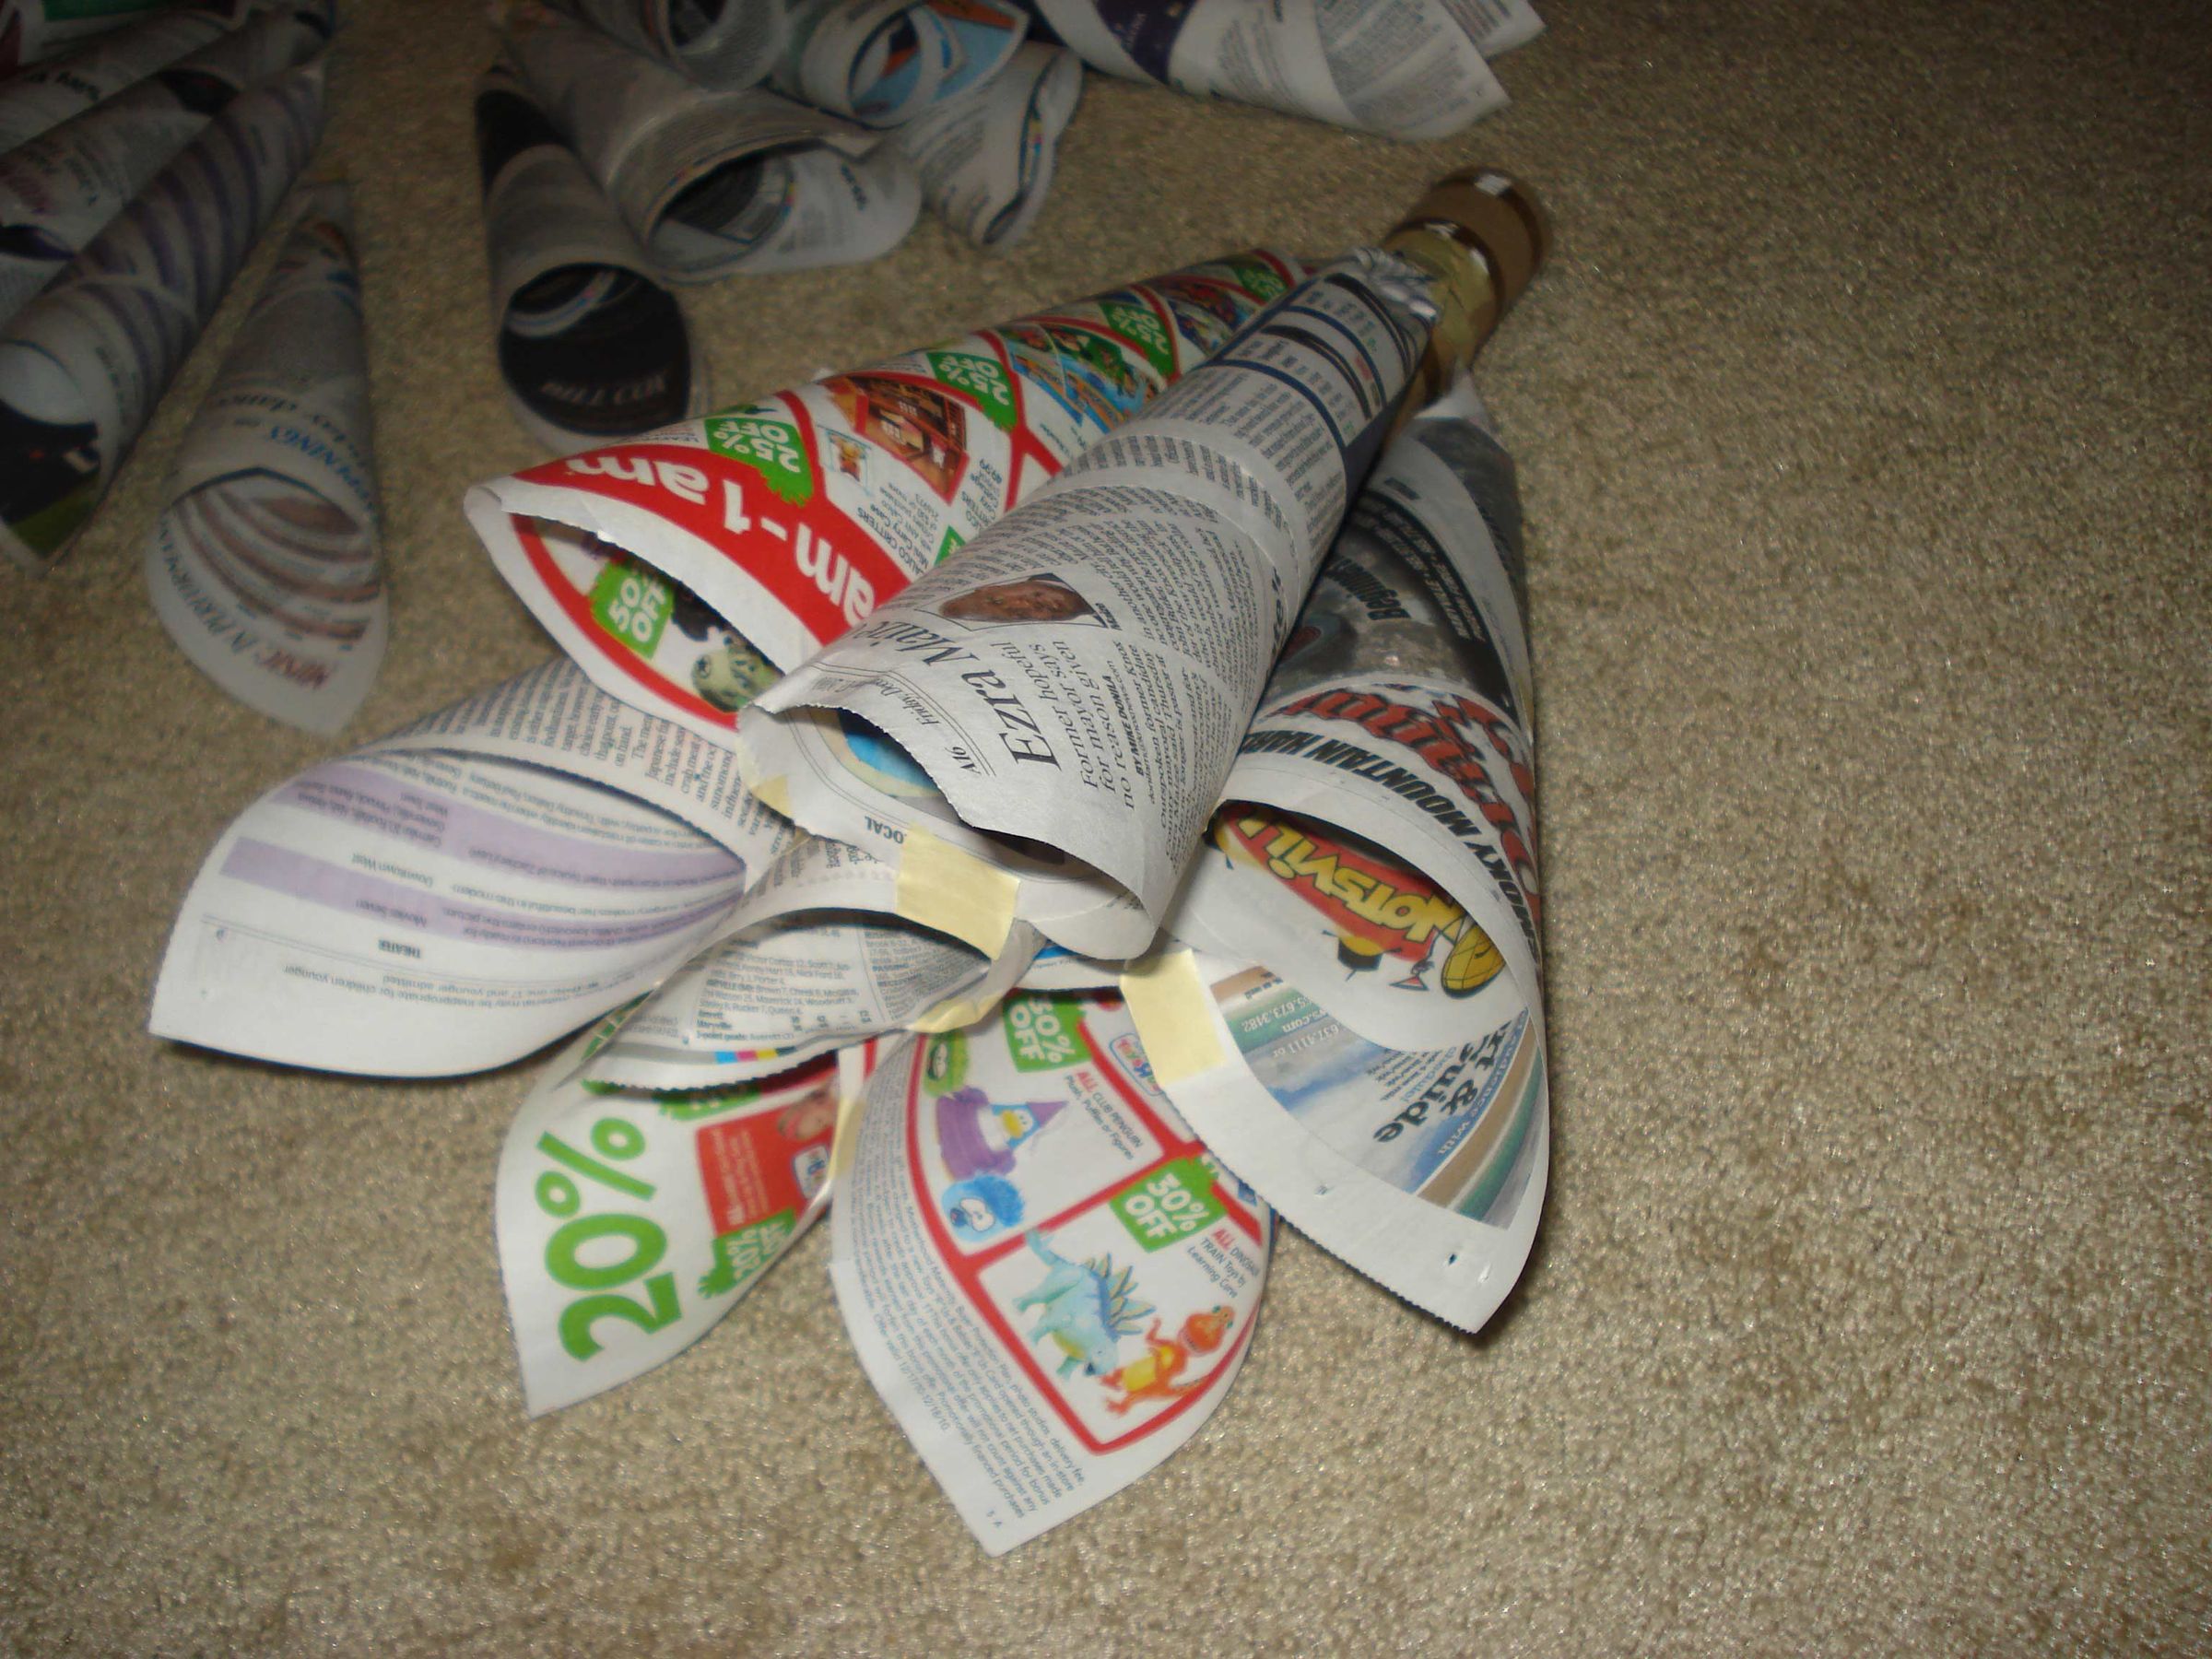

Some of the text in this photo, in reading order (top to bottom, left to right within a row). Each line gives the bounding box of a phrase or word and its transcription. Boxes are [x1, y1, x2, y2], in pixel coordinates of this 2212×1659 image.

[936, 360, 1009, 405] 25%
[939, 350, 999, 378] OFF
[712, 429, 800, 472] 25%
[715, 419, 789, 446] OFF
[567, 455, 708, 504] am
[856, 508, 896, 548] CRITTERS
[869, 504, 890, 527] Case
[890, 523, 912, 549] Carry
[794, 522, 874, 627] am
[1137, 547, 1176, 595] Knoxville
[1109, 581, 1155, 639] in another
[1175, 600, 1187, 619] the
[1175, 626, 1191, 654] John
[1142, 648, 1171, 718] Thursday
[1162, 669, 1182, 716] pastor
[959, 667, 1061, 770] Ezra
[989, 642, 1099, 789] Former hopeful
[1029, 642, 1115, 793] for mayor says
[1052, 641, 1134, 809] no reason given
[1101, 676, 1143, 775] BY MIKE DONILA
[1112, 641, 1169, 828] Outspoken former Knox
[1127, 644, 1171, 785] mayoral candidate
[615, 726, 632, 767] on hand.
[630, 739, 646, 759] The
[645, 735, 666, 781] Japanese
[663, 750, 679, 785] include
[680, 742, 702, 794] crab meat
[944, 743, 981, 773] A16
[695, 763, 712, 801] and the
[1311, 737, 1481, 835] MOUNTAIN
[865, 815, 907, 845] OCAL
[350, 855, 432, 885] Downtown West
[356, 901, 386, 915] Seven
[377, 941, 420, 959] THEATER
[285, 966, 327, 983] younger
[332, 977, 374, 995] children
[379, 987, 394, 998] for
[382, 973, 433, 992] admitted
[437, 981, 482, 995] younger
[396, 989, 476, 1009] inappropriate
[1010, 1006, 1046, 1057] OFF
[1030, 1003, 1076, 1061] 50%
[1272, 1047, 1285, 1057] or
[1076, 1069, 1144, 1148] ALL CLUB PENGUIN
[1371, 1035, 1488, 1147] Guide
[1432, 1077, 1482, 1119] &
[1063, 1074, 1135, 1160] Plush, Puffles or Figures
[1122, 1191, 1177, 1237] OFF
[535, 1117, 681, 1362] 20%
[1213, 1227, 1235, 1249] ALL
[1186, 1246, 1220, 1282] Learning
[1201, 1238, 1246, 1288] TRAIN Toys by
[904, 1348, 926, 1375] bonus
[934, 1390, 975, 1447] Promotionally
[971, 1443, 999, 1479] financed
[993, 1477, 1027, 1521] purchases
[996, 1388, 1023, 1421] opened
[1018, 1418, 1045, 1452] through
[1041, 1450, 1052, 1462] an
[1009, 1382, 1031, 1410] photo
[1048, 1436, 1075, 1470] delivery
[952, 1393, 970, 1413] offer
[966, 1412, 982, 1430] will
[976, 1427, 991, 1443] not
[986, 1441, 1006, 1466] count
[1001, 1464, 1028, 1498] against
[1021, 1494, 1040, 1514] any
[966, 1391, 1004, 1441] promotional
[999, 1438, 1024, 1469] period
[1019, 1465, 1032, 1479] for
[1029, 1477, 1051, 1506] bonus
[998, 1411, 1008, 1422] to
[1011, 1434, 1045, 1478] purchases
[1041, 1472, 1063, 1498] made
